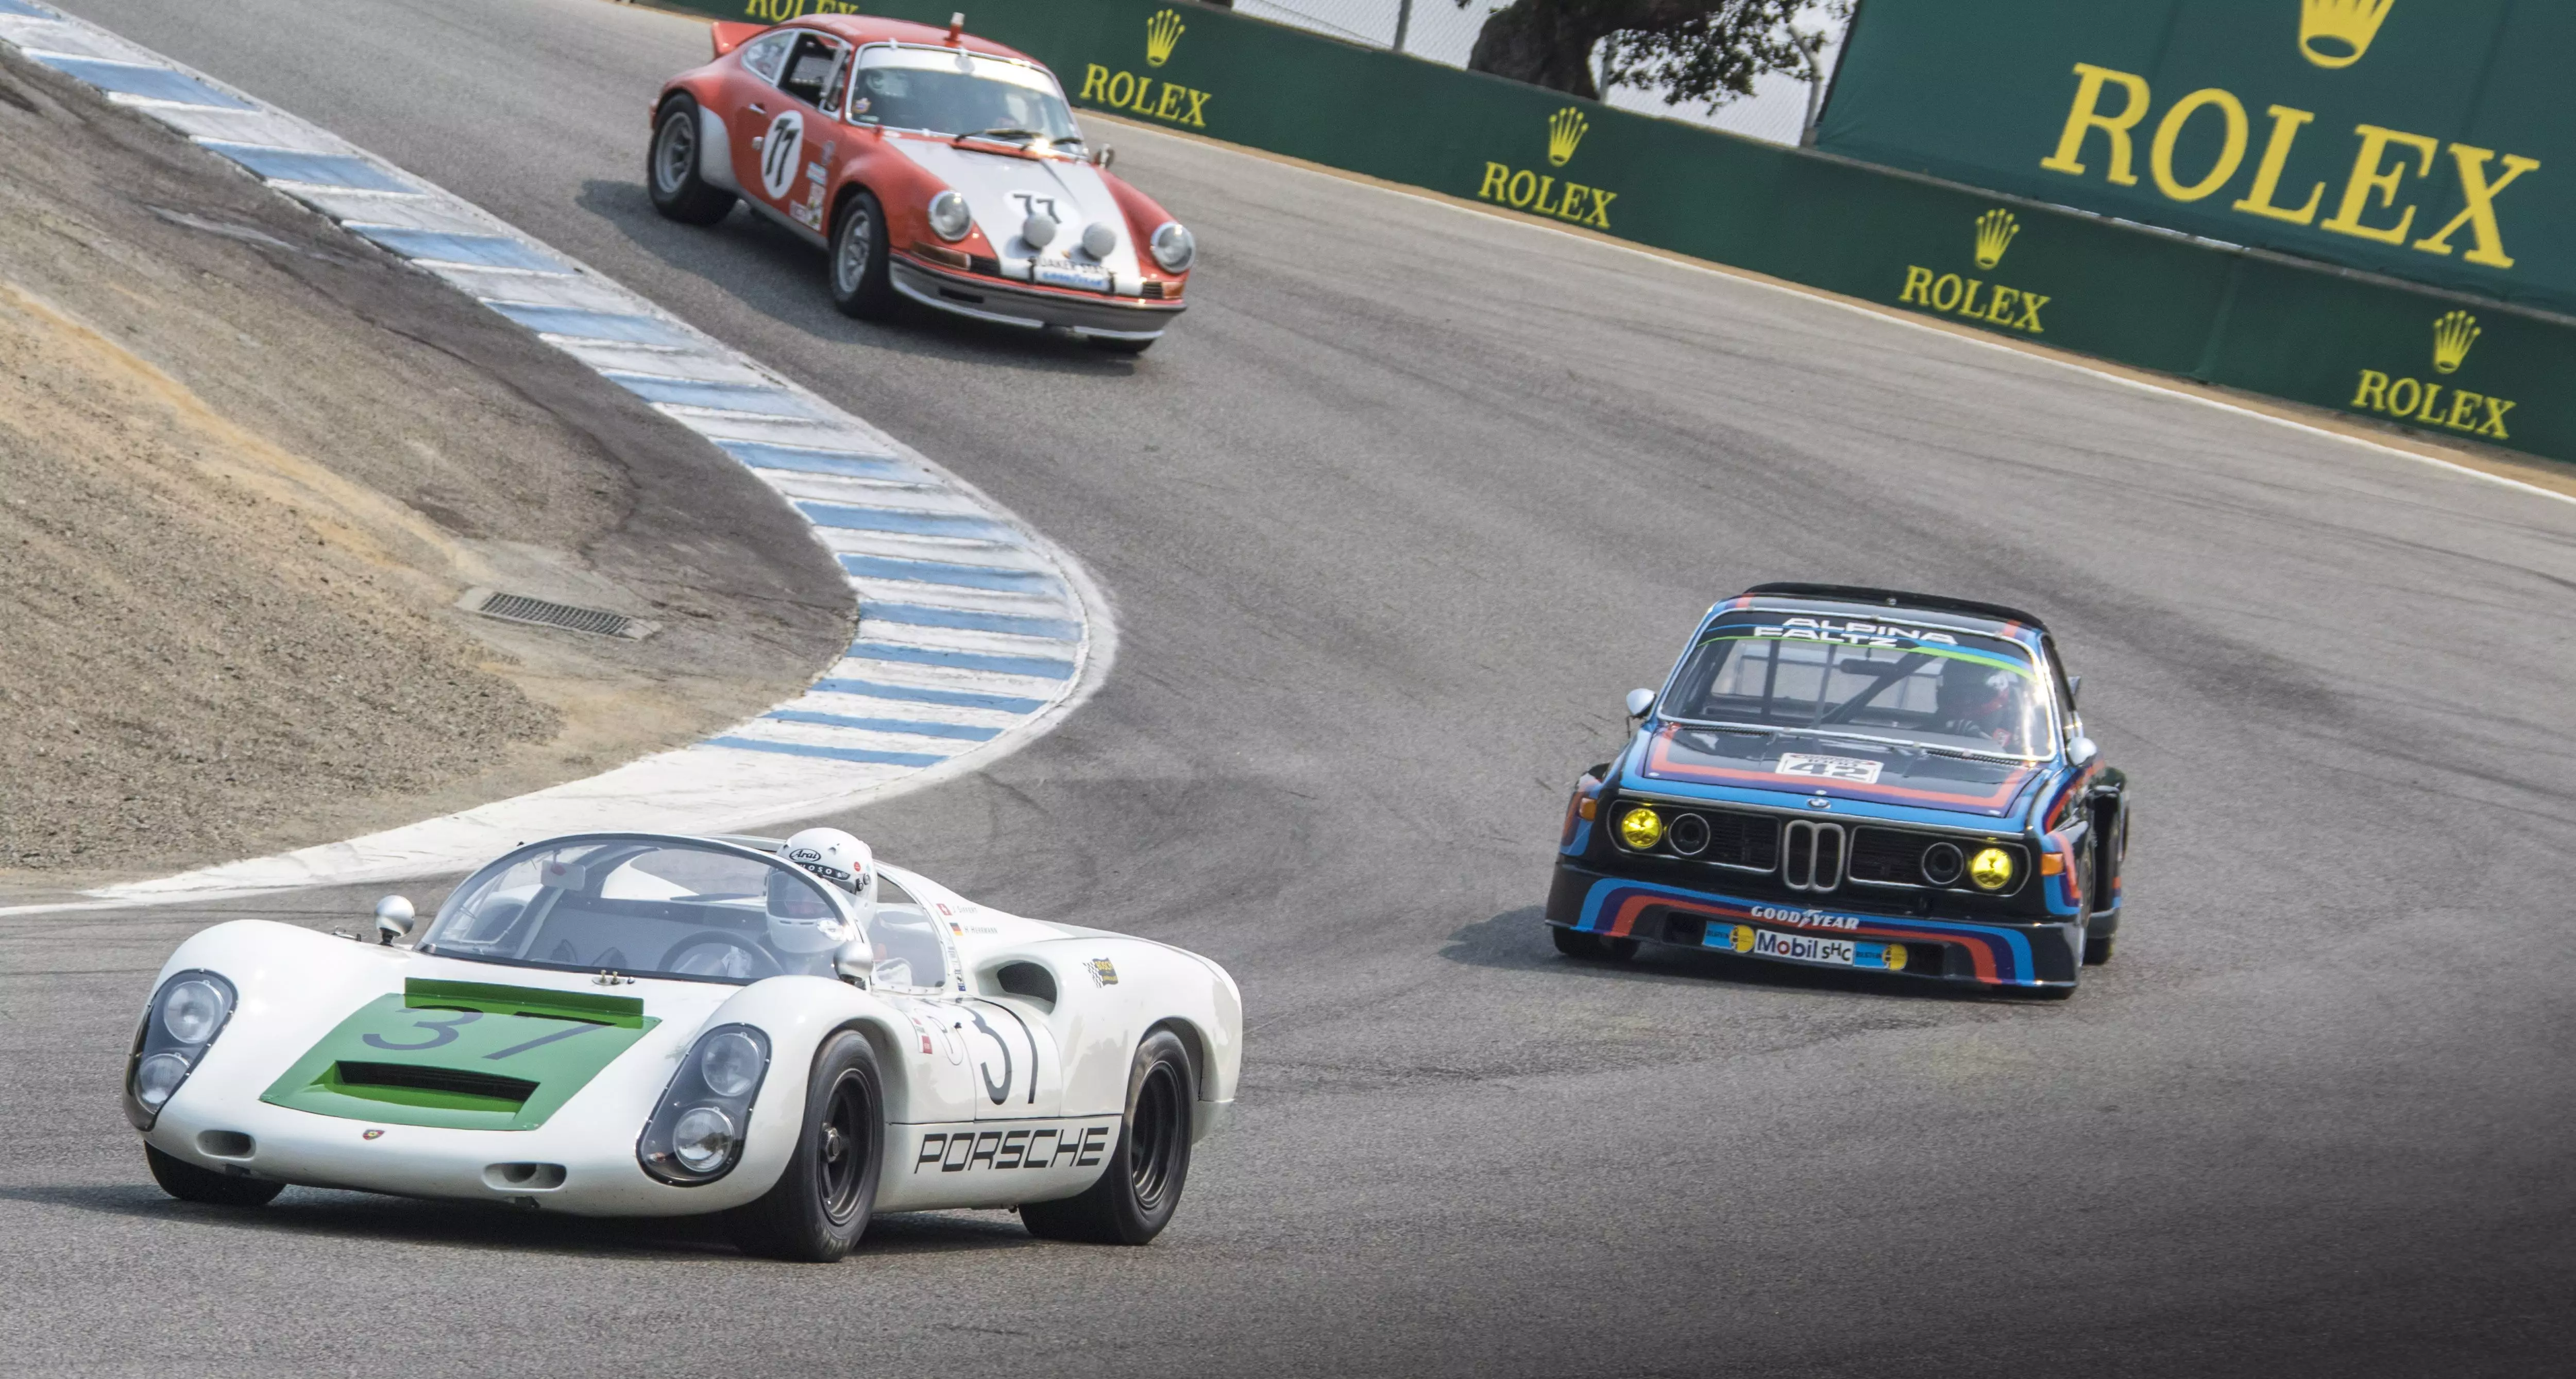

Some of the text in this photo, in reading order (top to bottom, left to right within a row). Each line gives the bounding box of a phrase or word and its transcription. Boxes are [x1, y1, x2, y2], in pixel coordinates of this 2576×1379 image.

[1079, 63, 1211, 128] ROLEX
[766, 118, 799, 188] 77
[2040, 62, 2540, 268] ROLEX
[1013, 193, 1062, 224] 77
[1478, 161, 1617, 229] ROLEX
[1899, 265, 2051, 333] ROLEX
[2350, 369, 2516, 439] ROLEX
[1753, 626, 1898, 648] FALTZ
[1782, 618, 1958, 645] ALPINA
[1789, 762, 1869, 781] 42
[795, 850, 818, 859] Arai
[1751, 906, 1859, 929] GOODYEAR
[1756, 931, 1819, 959] Mobil
[362, 1005, 618, 1060] 37
[914, 1127, 1109, 1174] PORSCHE
